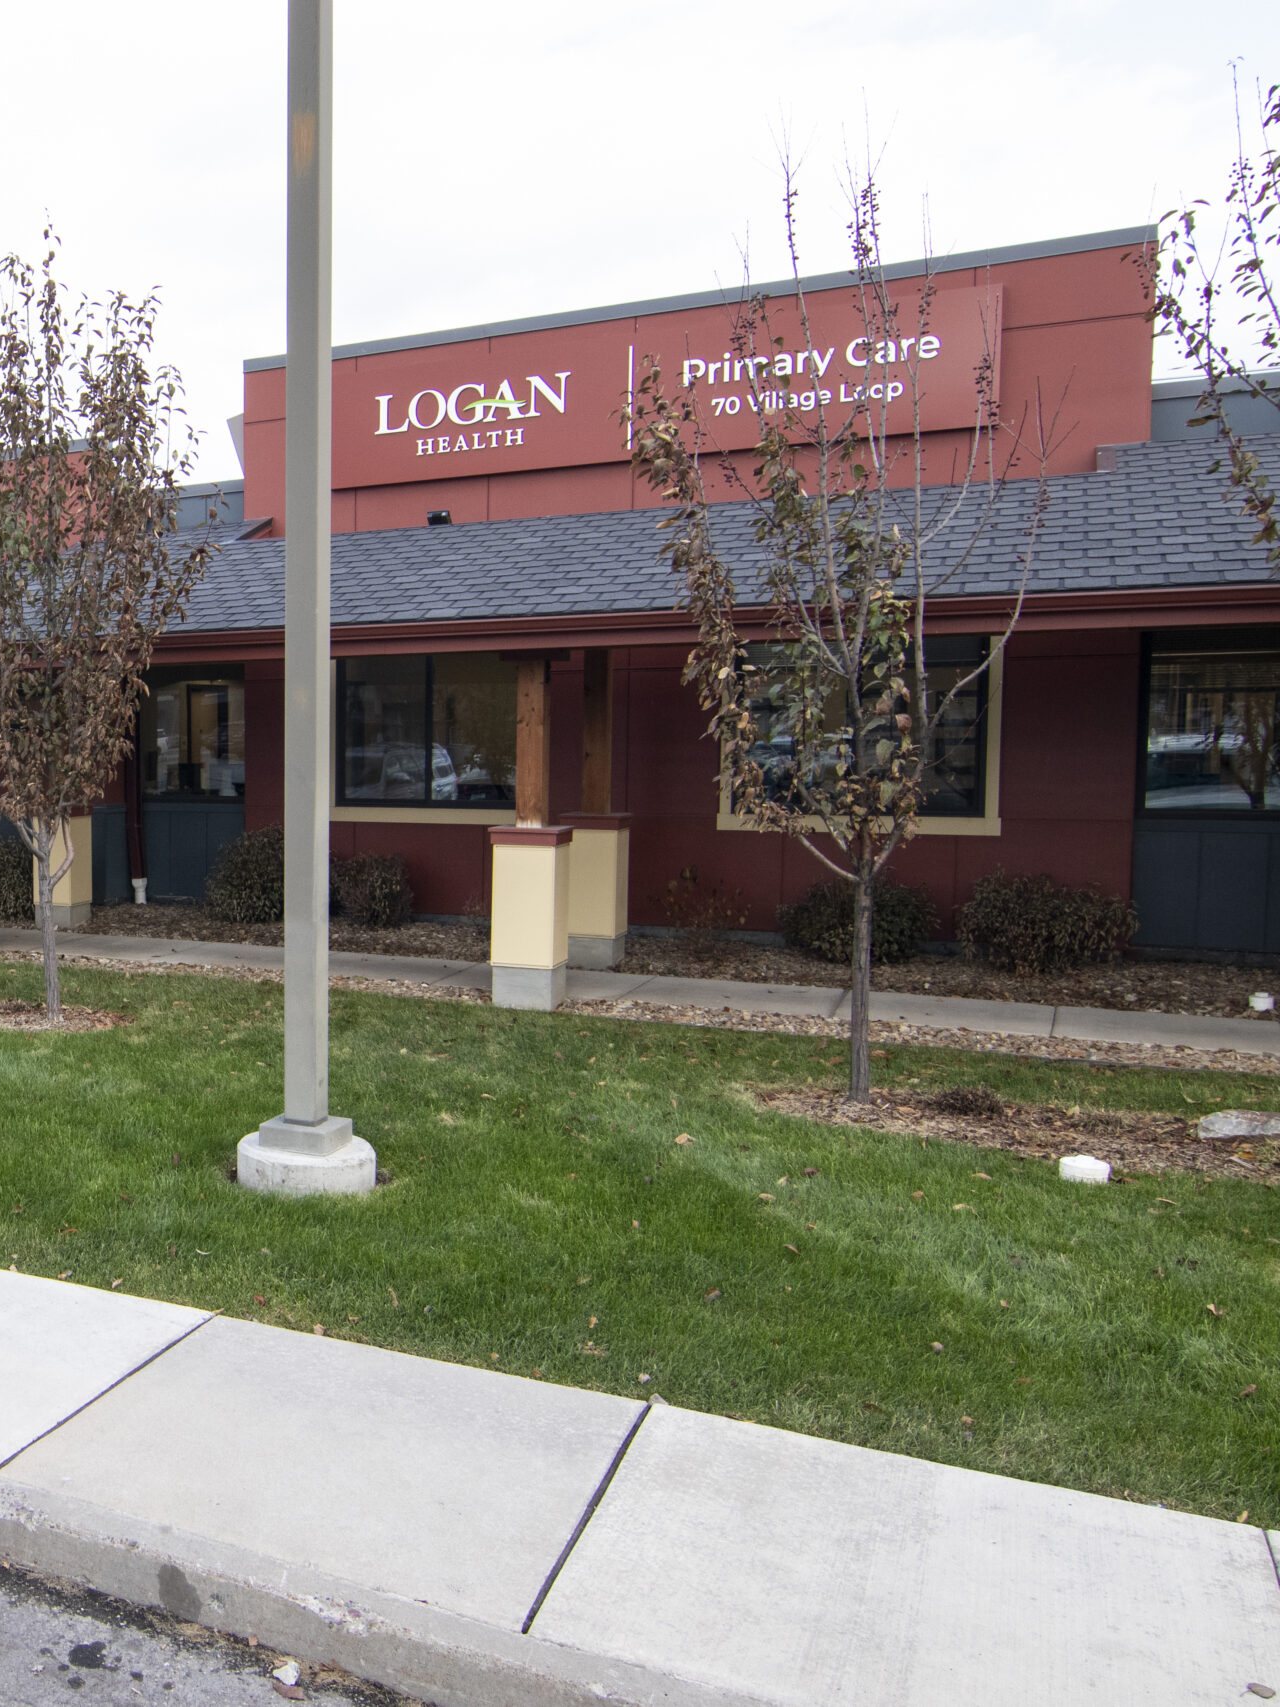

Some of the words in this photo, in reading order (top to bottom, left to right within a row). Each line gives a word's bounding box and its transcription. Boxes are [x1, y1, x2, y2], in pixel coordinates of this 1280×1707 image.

[682, 348, 835, 387] Primary
[846, 335, 942, 367] Care
[374, 371, 571, 435] LOGAN
[711, 396, 741, 416] 70
[746, 390, 832, 412] Village
[416, 428, 524, 456] HEALTH
